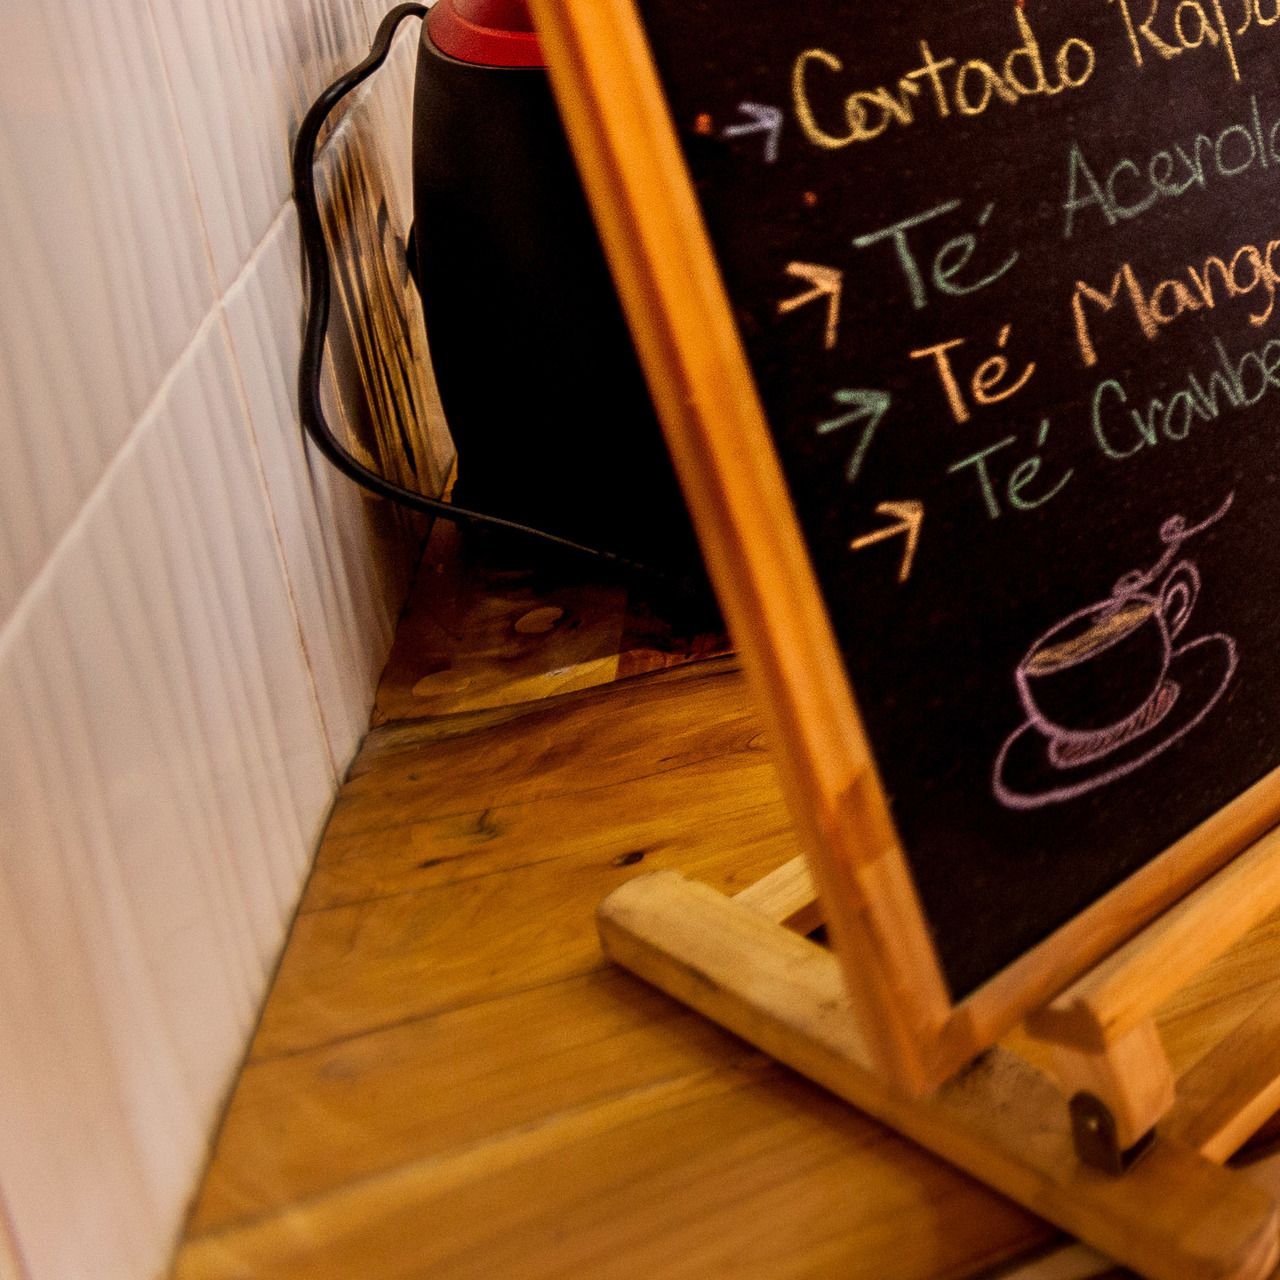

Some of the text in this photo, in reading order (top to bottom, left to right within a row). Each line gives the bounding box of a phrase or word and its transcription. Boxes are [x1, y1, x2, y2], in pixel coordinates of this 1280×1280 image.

[791, 5, 1096, 150] Cortado
[851, 198, 1019, 310] Té
[908, 322, 1037, 423] Té
[947, 418, 1074, 519] Té
